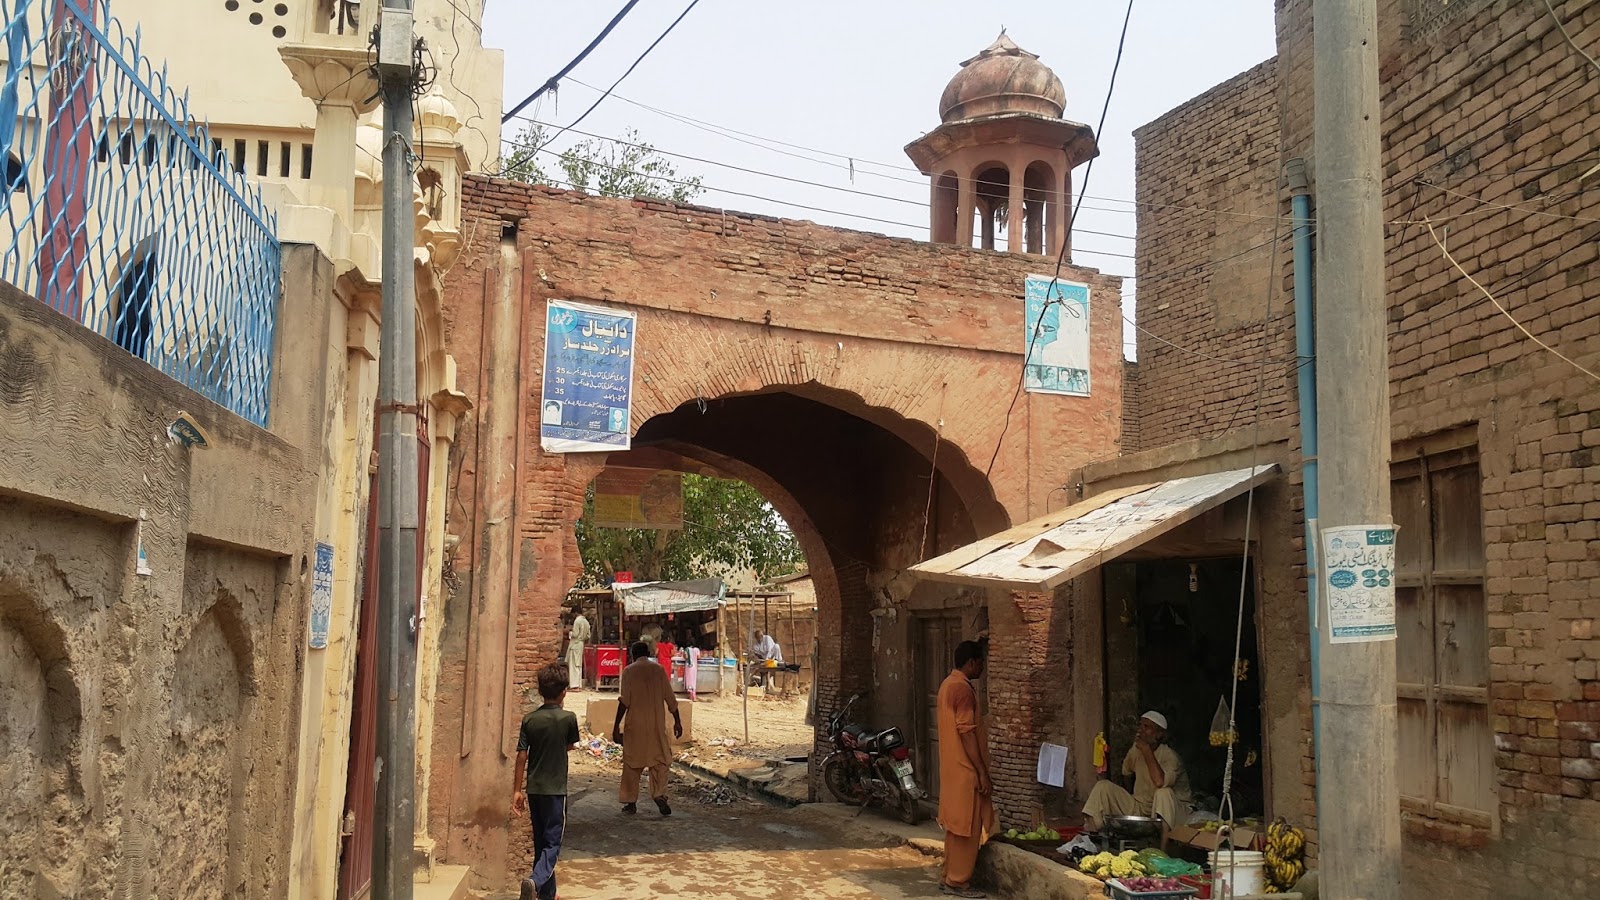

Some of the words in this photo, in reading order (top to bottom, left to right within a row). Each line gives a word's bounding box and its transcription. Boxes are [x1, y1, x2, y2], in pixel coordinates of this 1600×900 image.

[582, 320, 627, 339] دانیال
[556, 366, 566, 374] 25
[554, 387, 565, 395] 35
